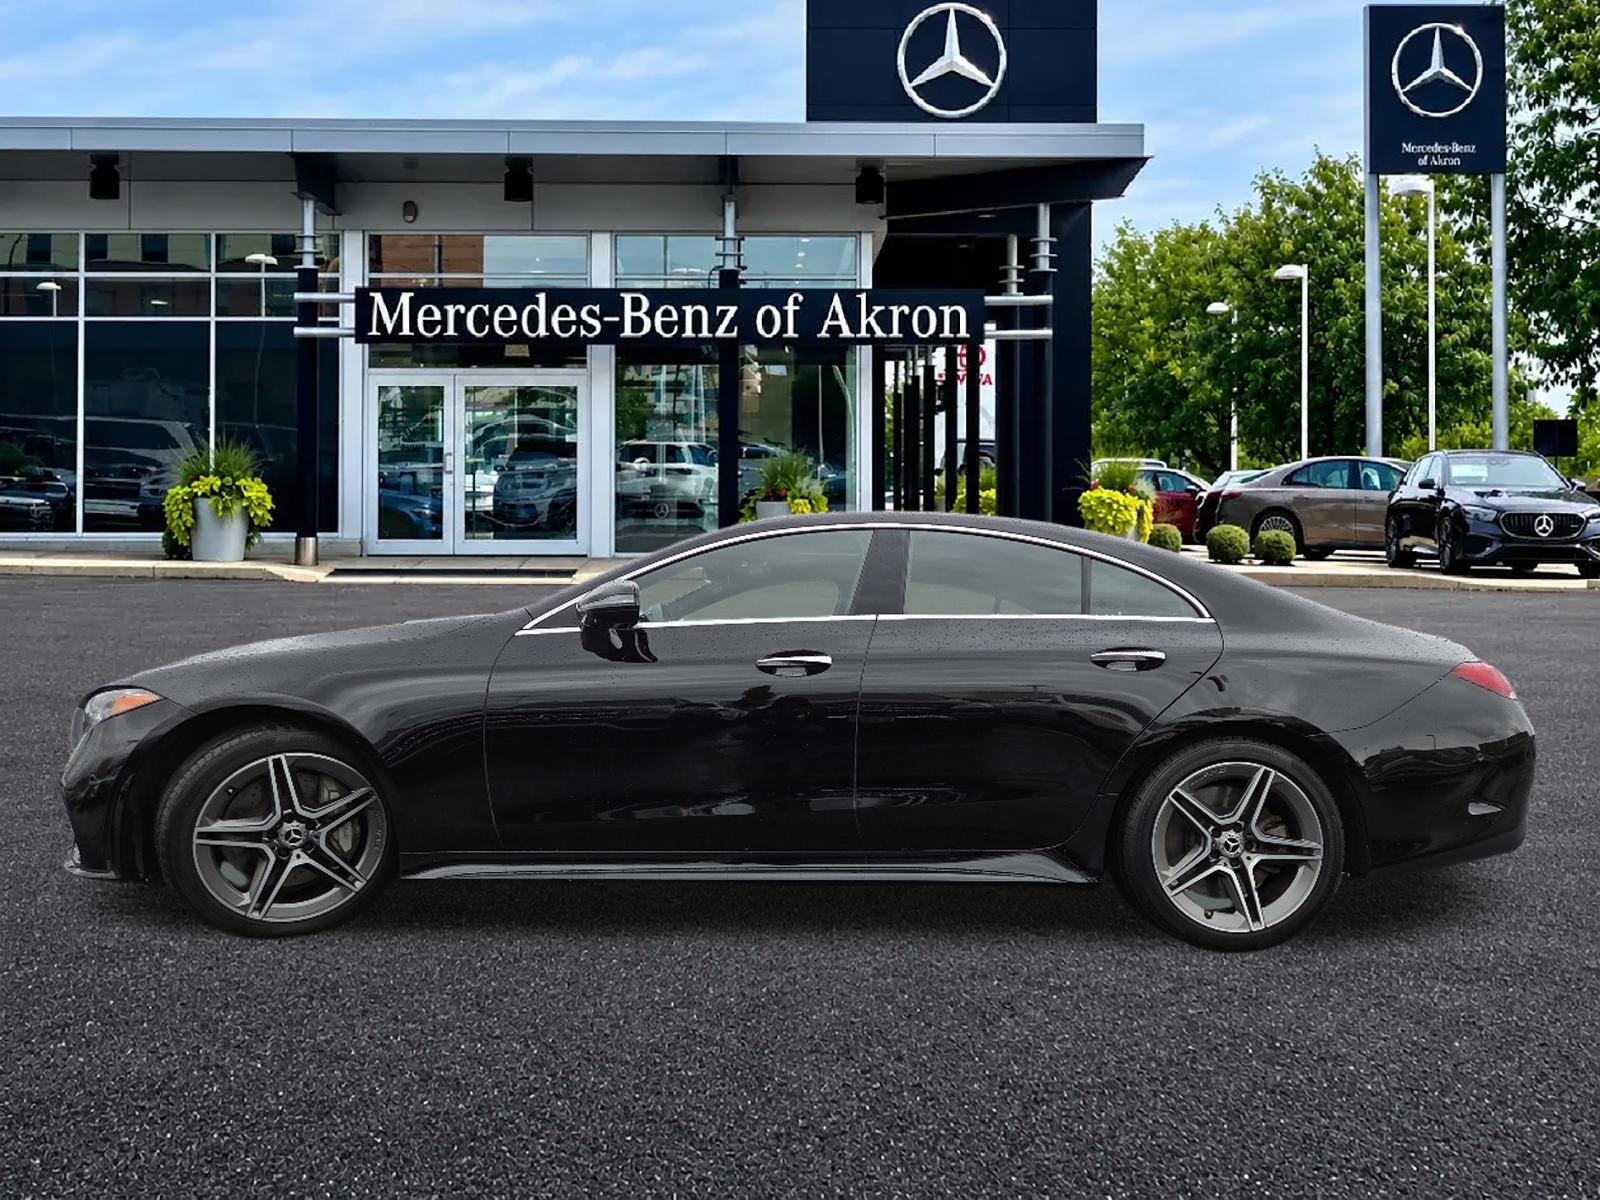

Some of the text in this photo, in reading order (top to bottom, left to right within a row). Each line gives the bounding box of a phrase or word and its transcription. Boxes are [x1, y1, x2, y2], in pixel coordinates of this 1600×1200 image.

[1401, 141, 1477, 154] Mercedes-Benz
[1417, 154, 1461, 166] of Akron
[367, 291, 971, 339] Mercedes-Benz of Akron
